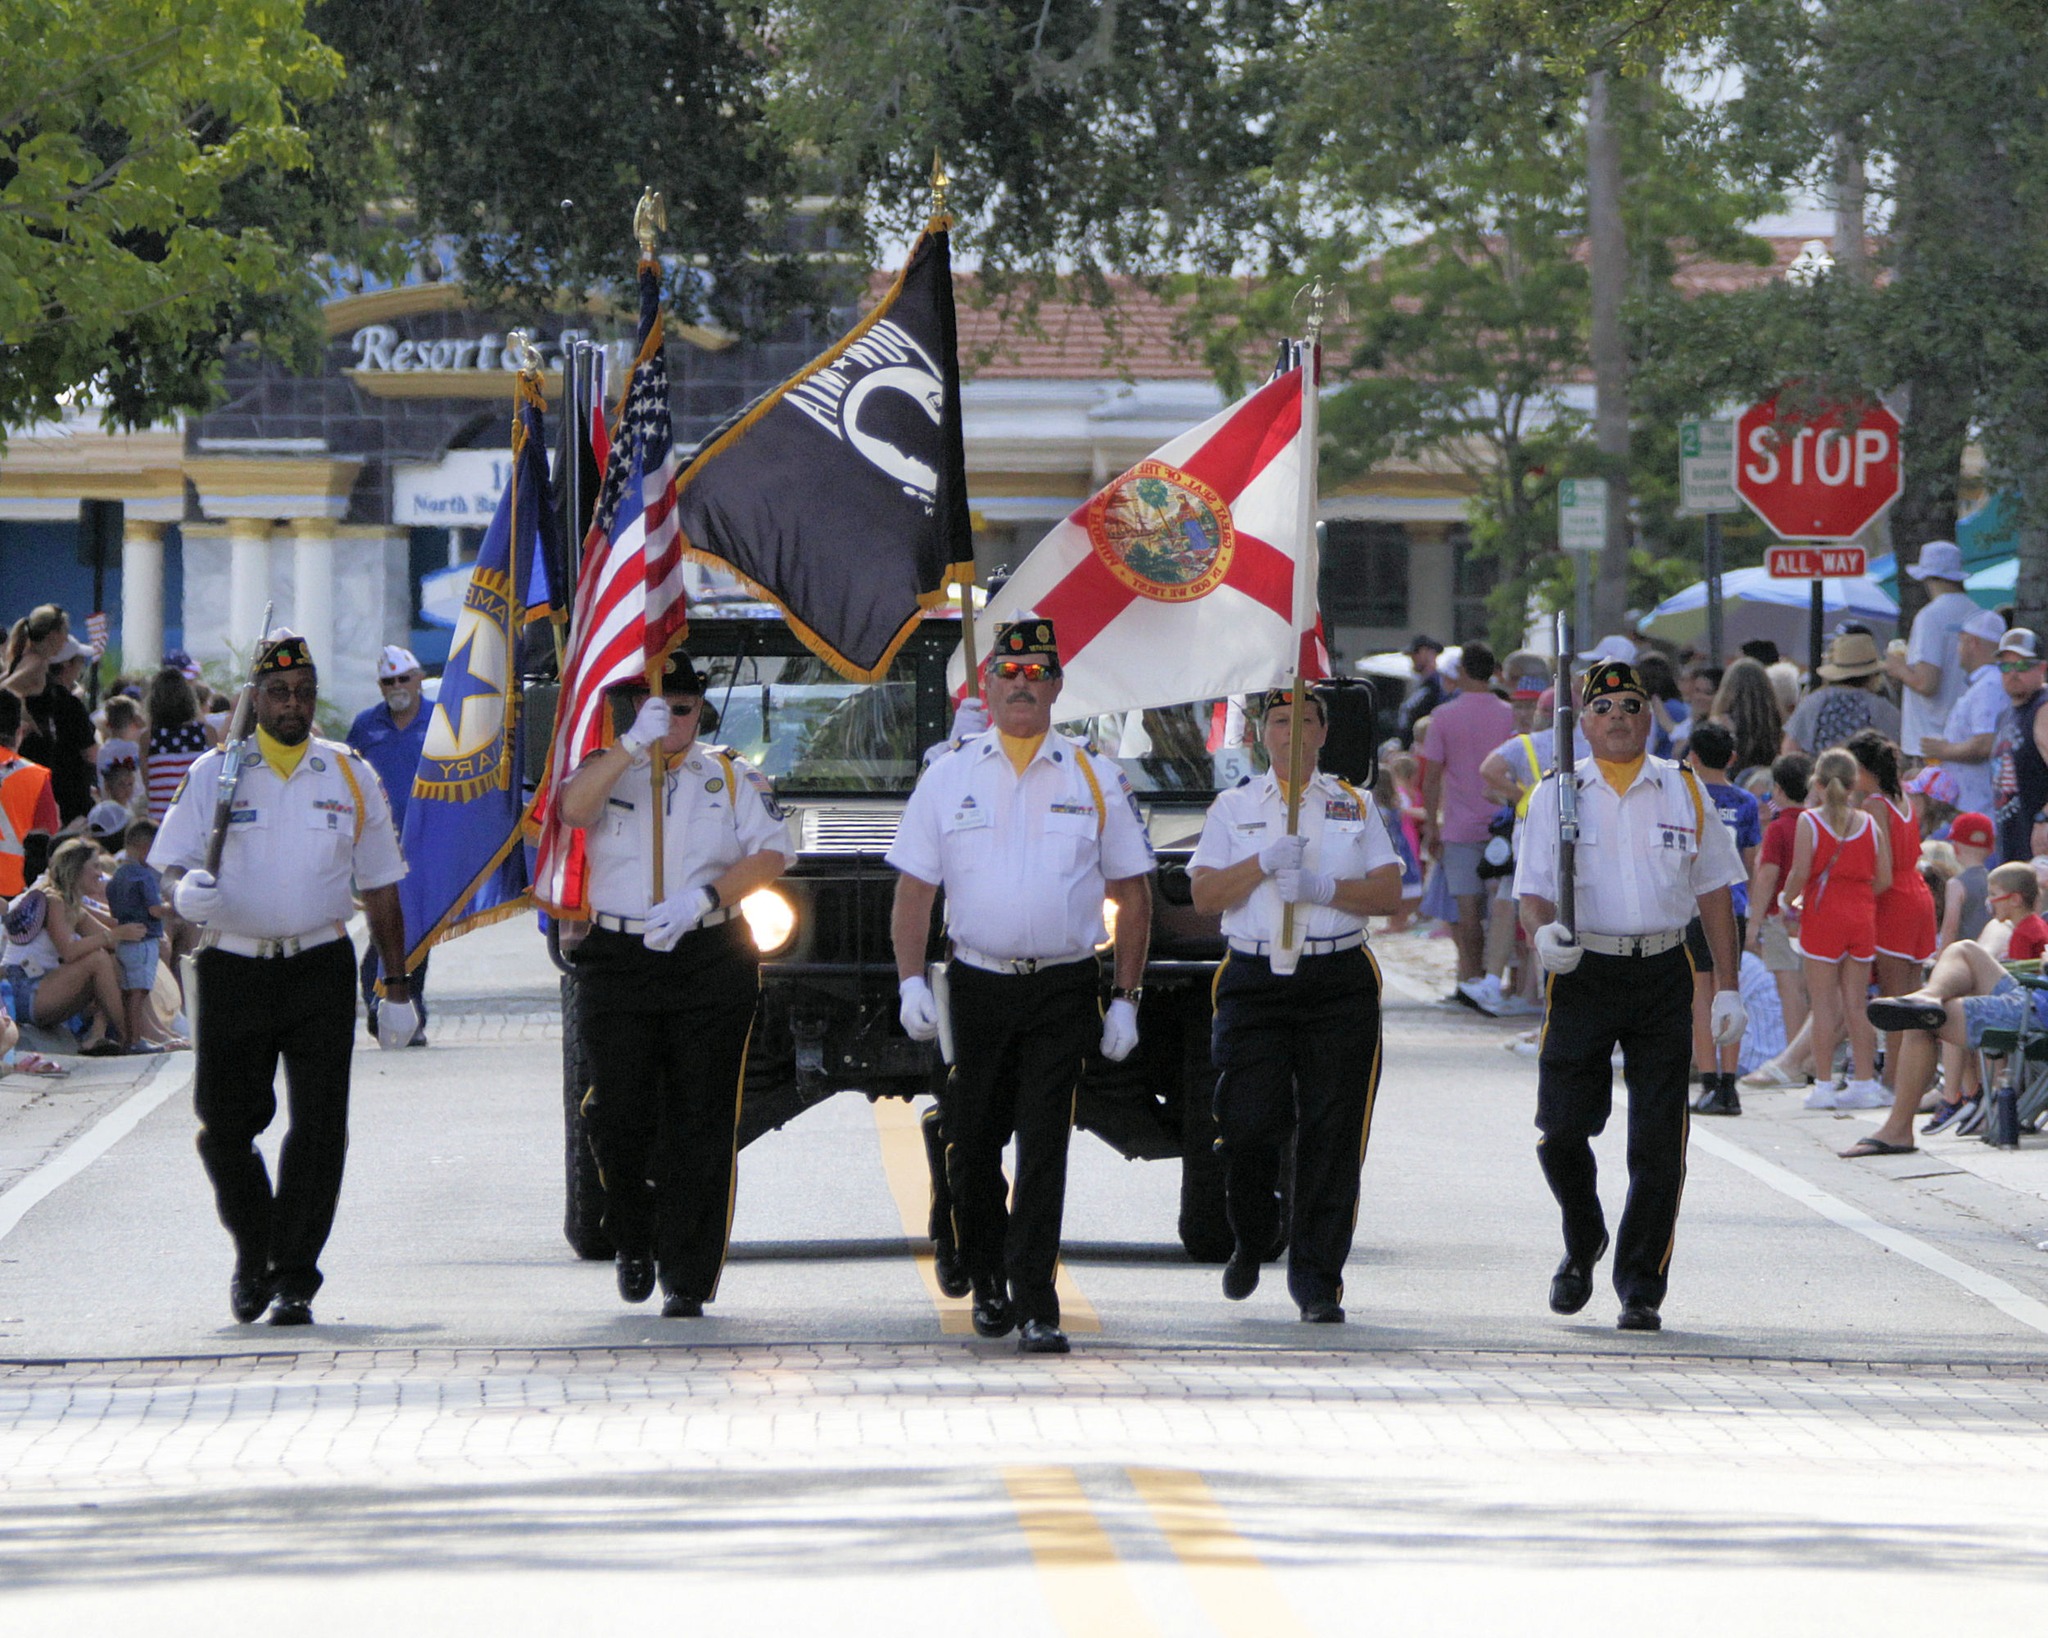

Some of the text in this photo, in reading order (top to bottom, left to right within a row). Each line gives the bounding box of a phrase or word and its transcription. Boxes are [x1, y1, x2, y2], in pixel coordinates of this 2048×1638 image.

[352, 325, 498, 371] Resort
[1745, 425, 1890, 487] STOP
[1775, 552, 1860, 573] ALL WAY
[1225, 758, 1240, 780] 5
